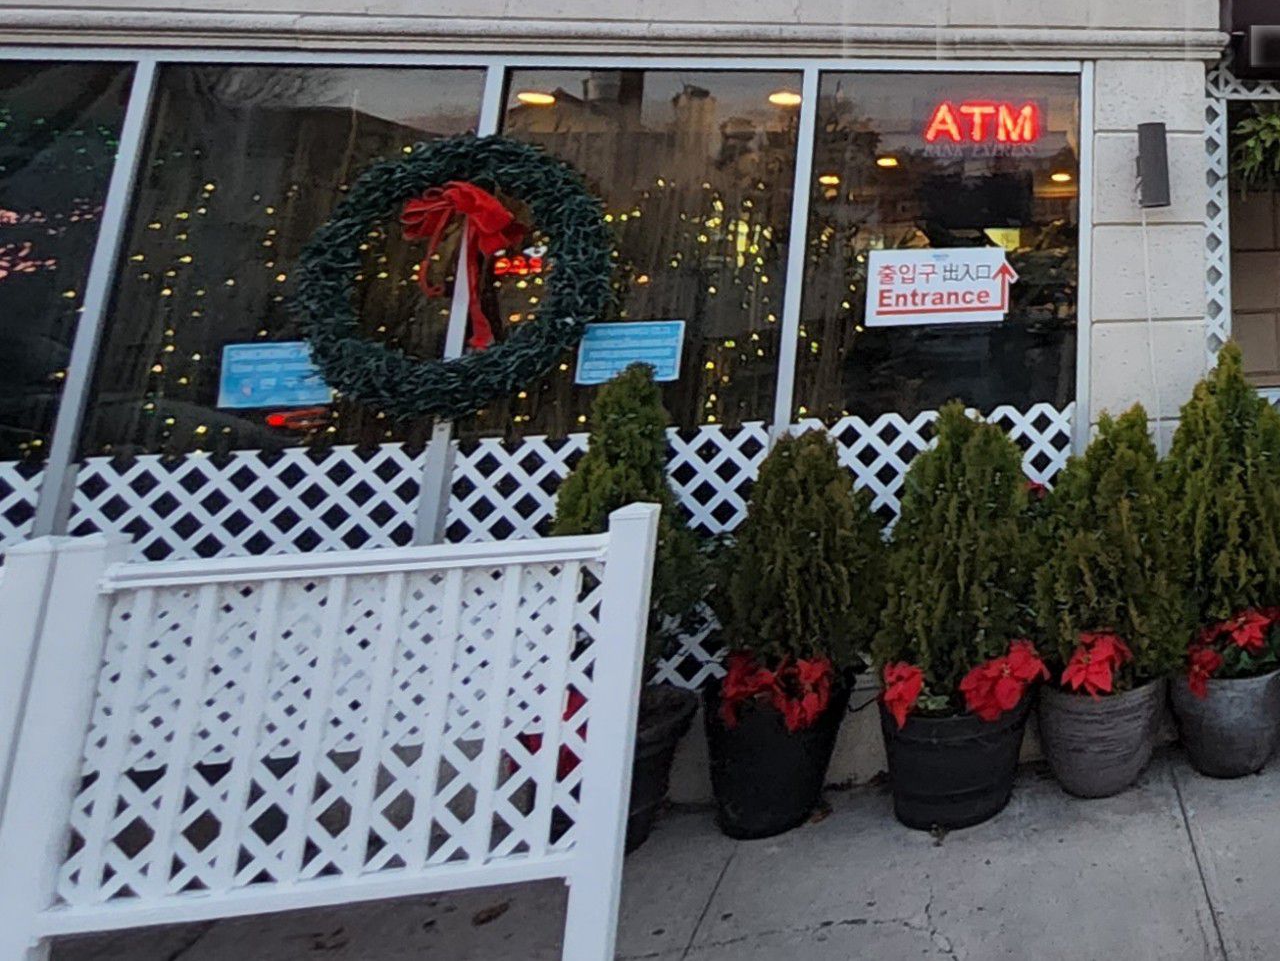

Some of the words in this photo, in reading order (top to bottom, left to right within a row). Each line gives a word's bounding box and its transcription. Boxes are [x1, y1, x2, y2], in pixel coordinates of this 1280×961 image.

[925, 102, 1036, 142] ATM
[878, 263, 937, 285] 출입구
[943, 262, 991, 282] 出入口
[878, 288, 990, 307] Entrance
